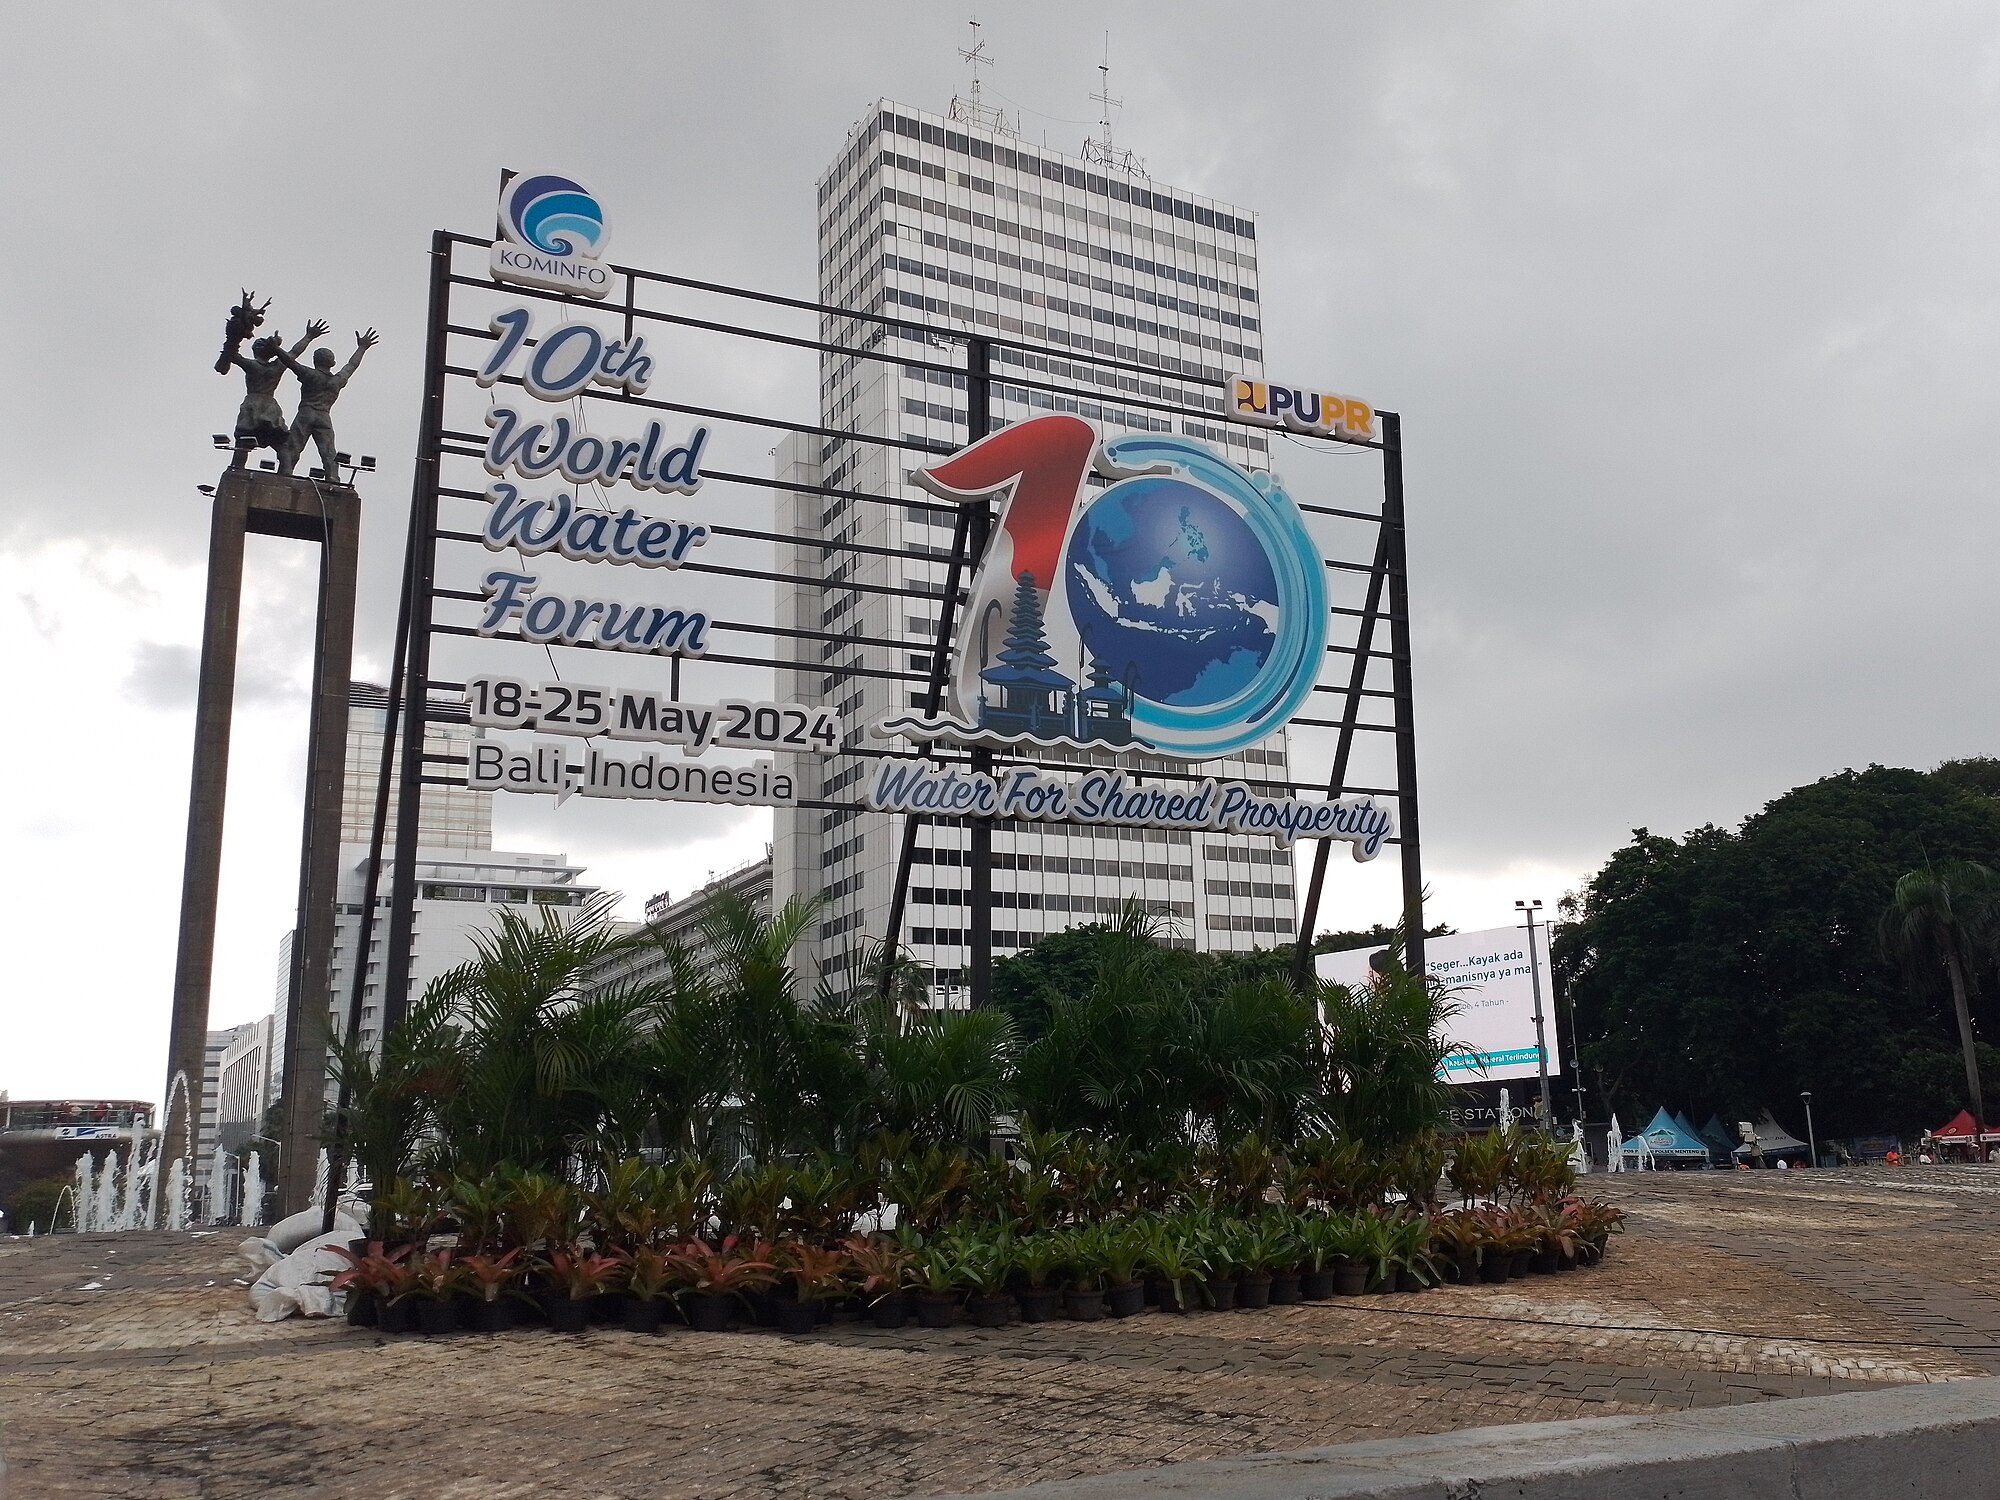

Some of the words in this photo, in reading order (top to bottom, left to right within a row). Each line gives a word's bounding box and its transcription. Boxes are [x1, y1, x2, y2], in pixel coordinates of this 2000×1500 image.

[500, 250, 606, 284] KOMINFO
[484, 309, 653, 391] 10th
[1268, 385, 1371, 433] PUPR
[490, 409, 707, 485] World
[489, 483, 706, 561] Water
[484, 570, 705, 650] Forum
[472, 680, 602, 725] 18-25
[619, 695, 712, 747] May
[725, 704, 836, 747] 2024
[475, 744, 572, 790] Bali,
[589, 751, 793, 800] Indonesia
[876, 763, 995, 811] Water
[1004, 772, 1067, 814] For
[1074, 774, 1211, 822] Shared
[1219, 787, 1390, 855] Prosperity
[1499, 968, 1511, 980] ya
[1503, 950, 1523, 961] ada
[1481, 999, 1505, 1008] Tahun
[1464, 1107, 1534, 1120] STATON
